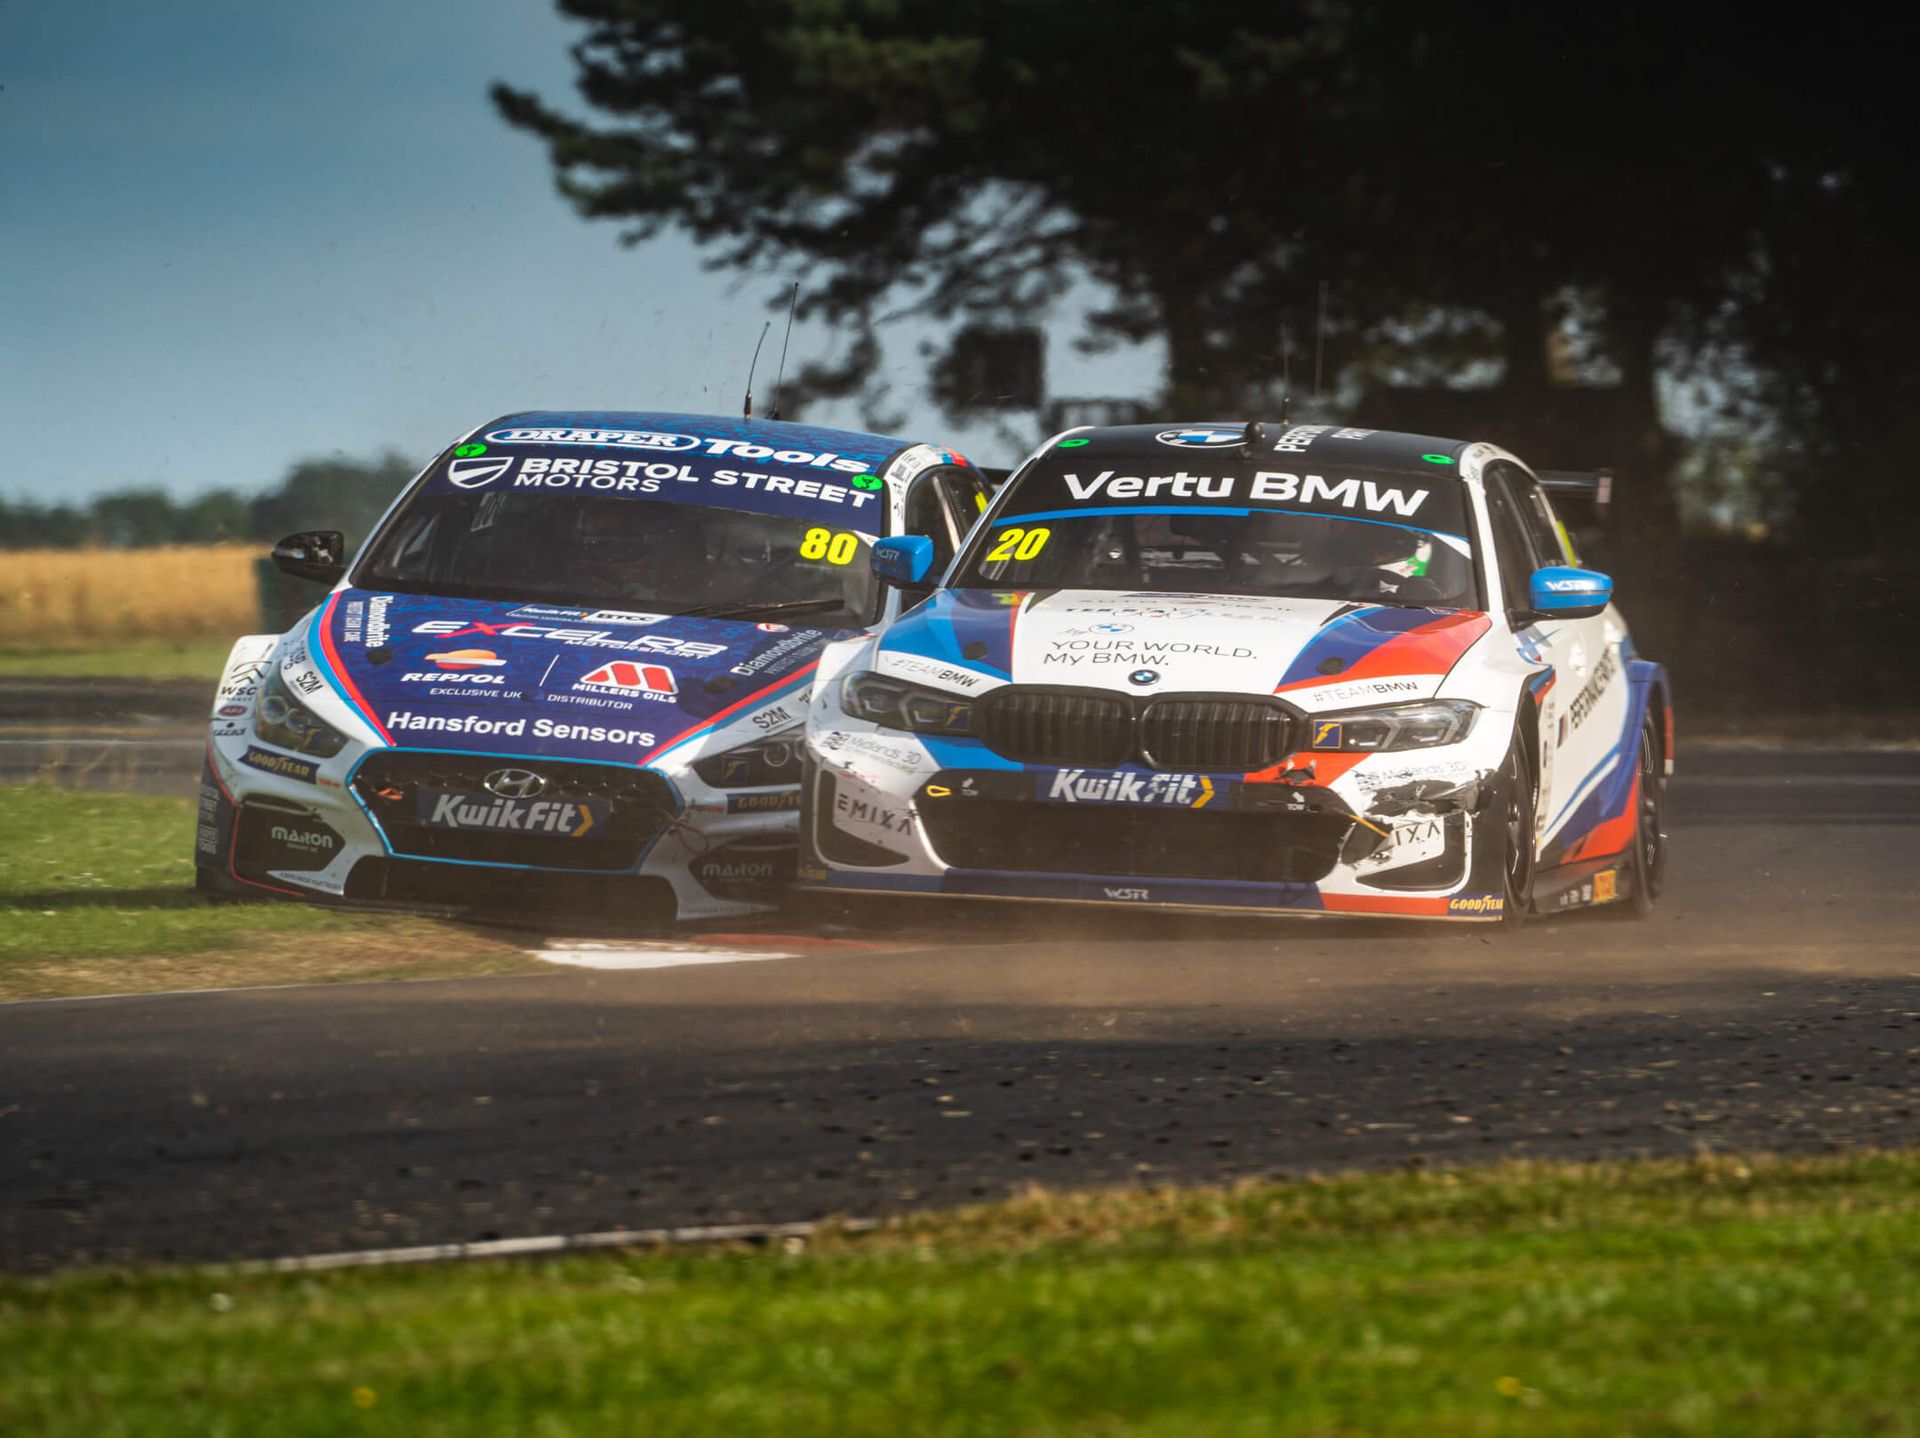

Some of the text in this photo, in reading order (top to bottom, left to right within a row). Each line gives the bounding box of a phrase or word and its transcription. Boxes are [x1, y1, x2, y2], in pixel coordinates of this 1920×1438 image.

[504, 430, 870, 473] DRAPER Tools
[513, 474, 661, 493] MOTORS
[520, 458, 699, 482] BRISTOL
[711, 470, 875, 508] STREET
[1063, 471, 1429, 517] Vertu BMW
[800, 527, 859, 566] 80
[986, 528, 1051, 562] 20
[411, 620, 728, 656] EXCELR8
[1043, 653, 1170, 666] My BMW.
[1051, 640, 1258, 660] YOUR WORLD.
[400, 672, 506, 685] REPSOL
[221, 686, 258, 696] WSC
[429, 687, 522, 699] EXCLUSIVE UK
[547, 693, 633, 711] DISTRIBUTOR
[571, 683, 677, 704] MILLERS OILS
[752, 706, 792, 729] S2M
[387, 711, 655, 747] Hansford Sensors
